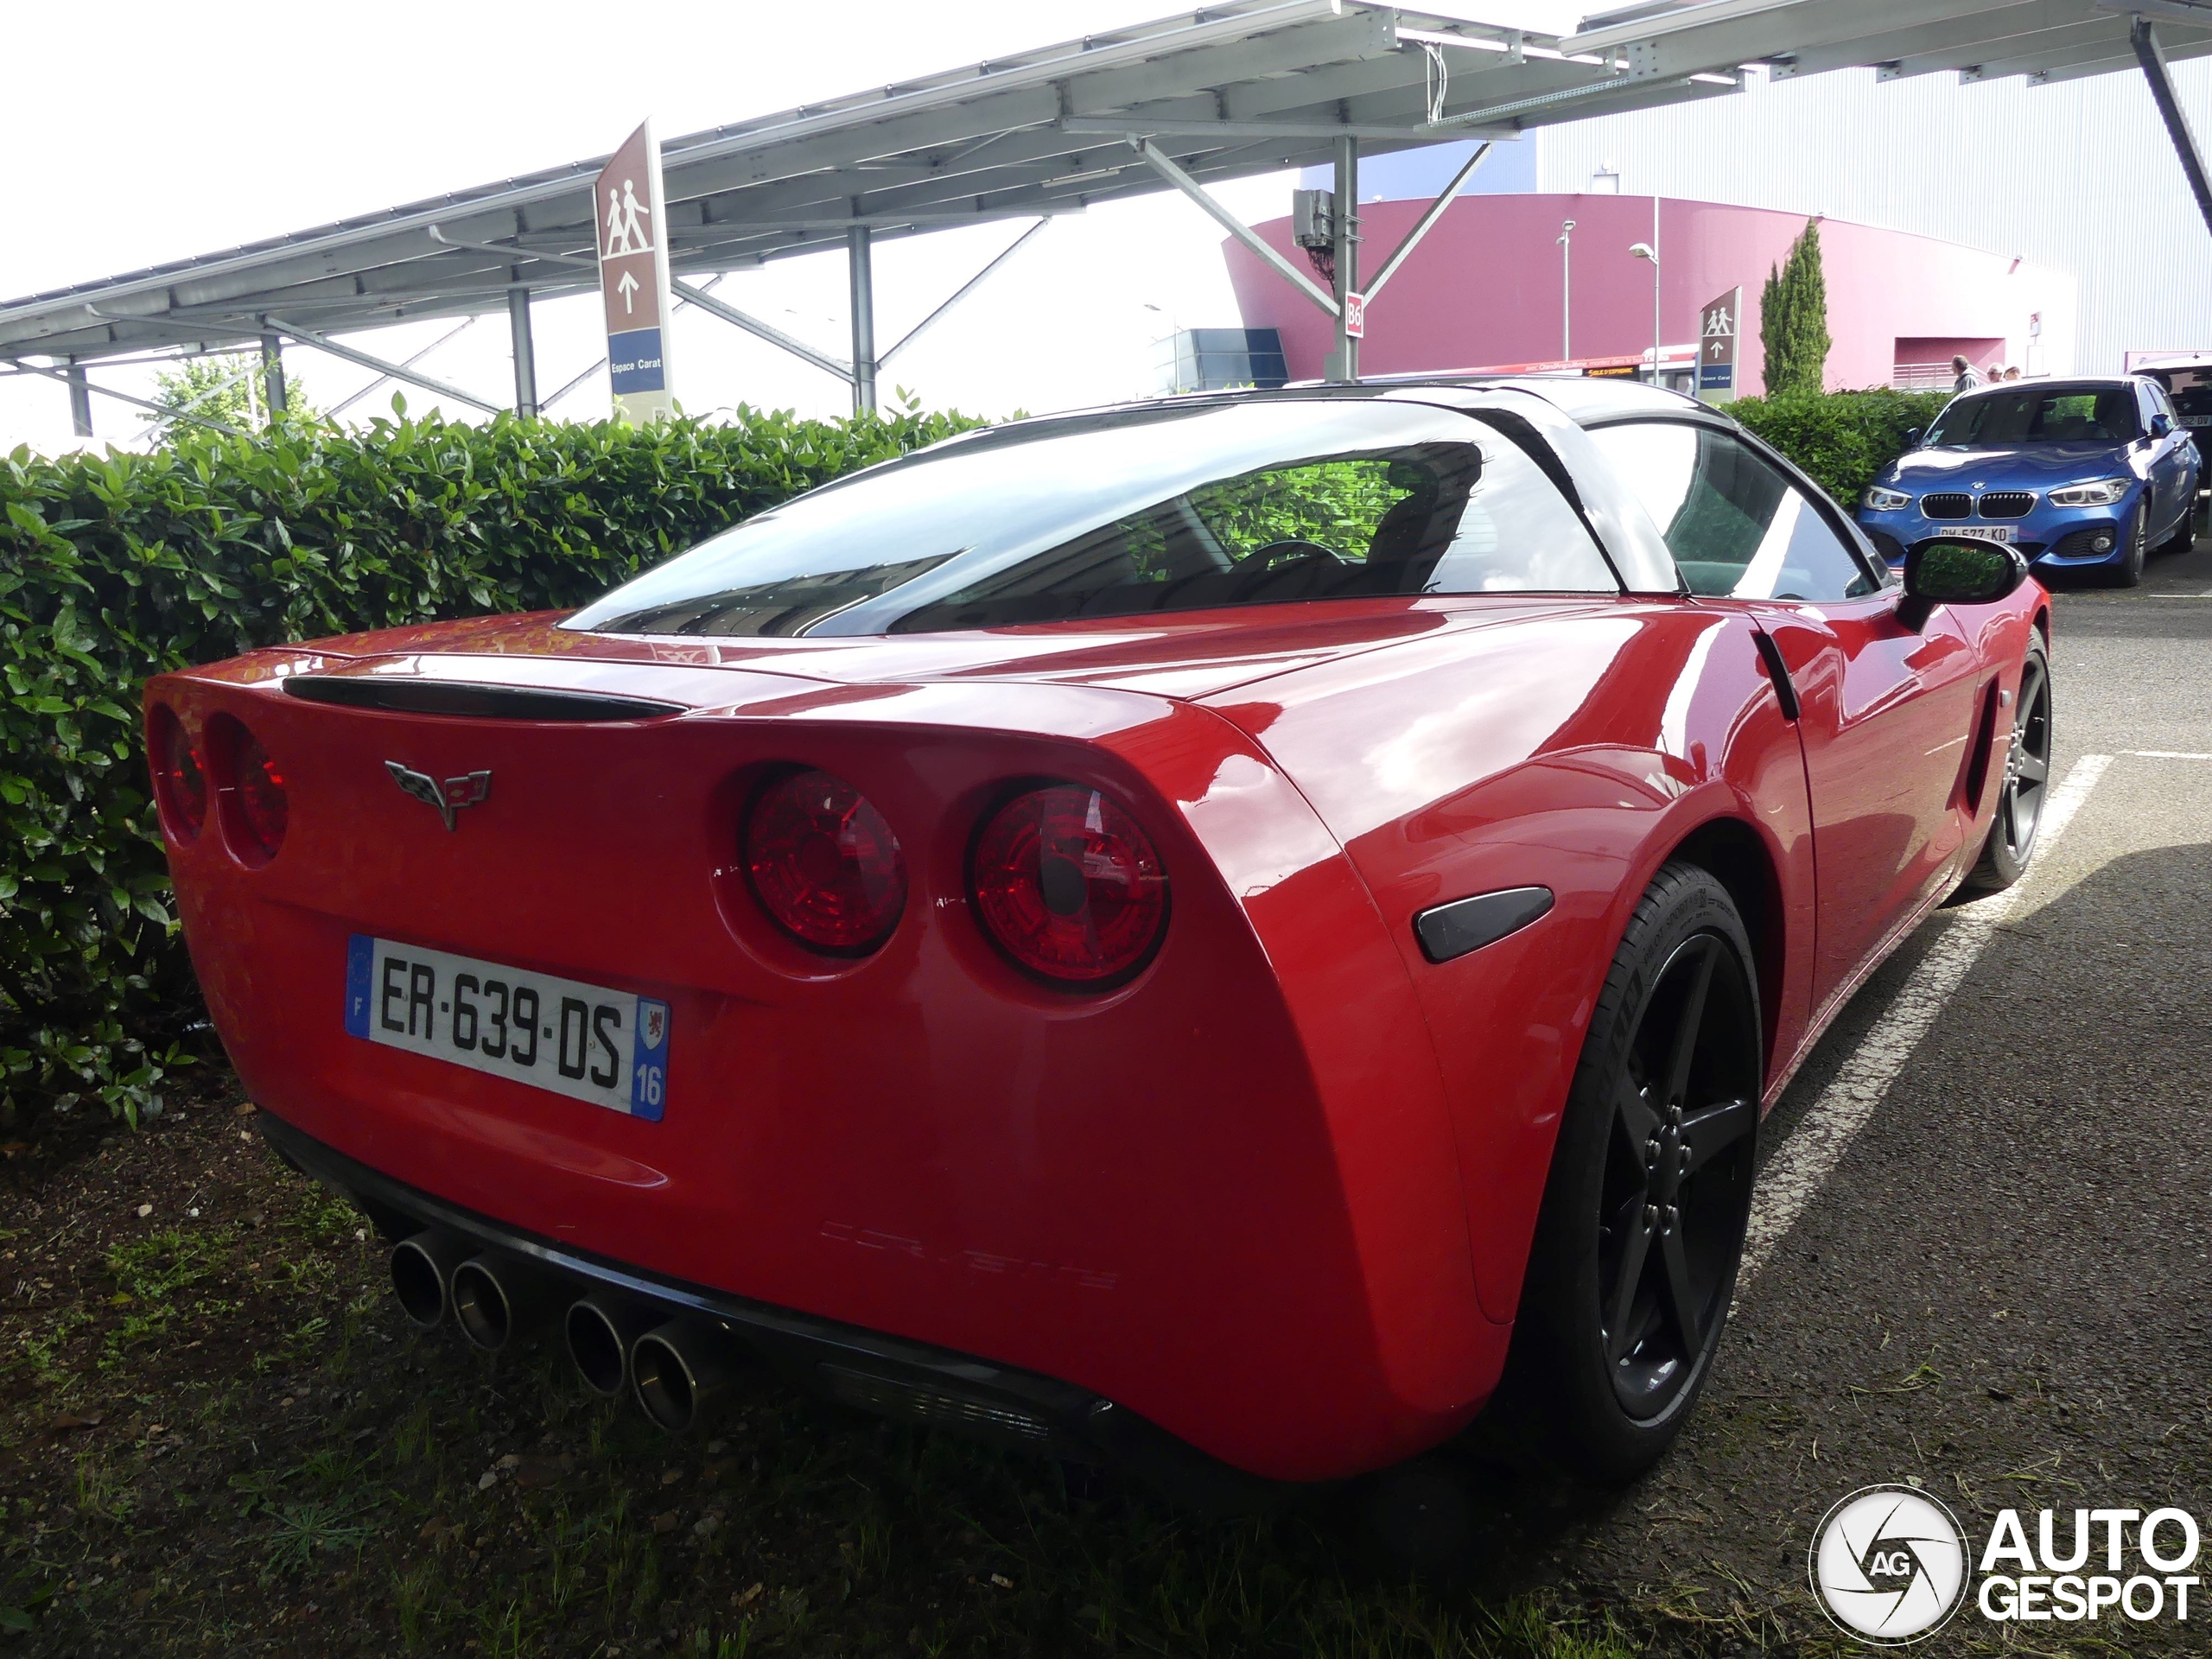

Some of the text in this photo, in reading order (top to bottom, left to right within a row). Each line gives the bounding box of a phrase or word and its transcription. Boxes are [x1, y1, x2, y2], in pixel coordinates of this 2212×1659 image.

[1348, 302, 1361, 327] B6
[612, 359, 661, 374] Espace Carat
[353, 996, 363, 1016] F
[636, 1064, 662, 1106] 16
